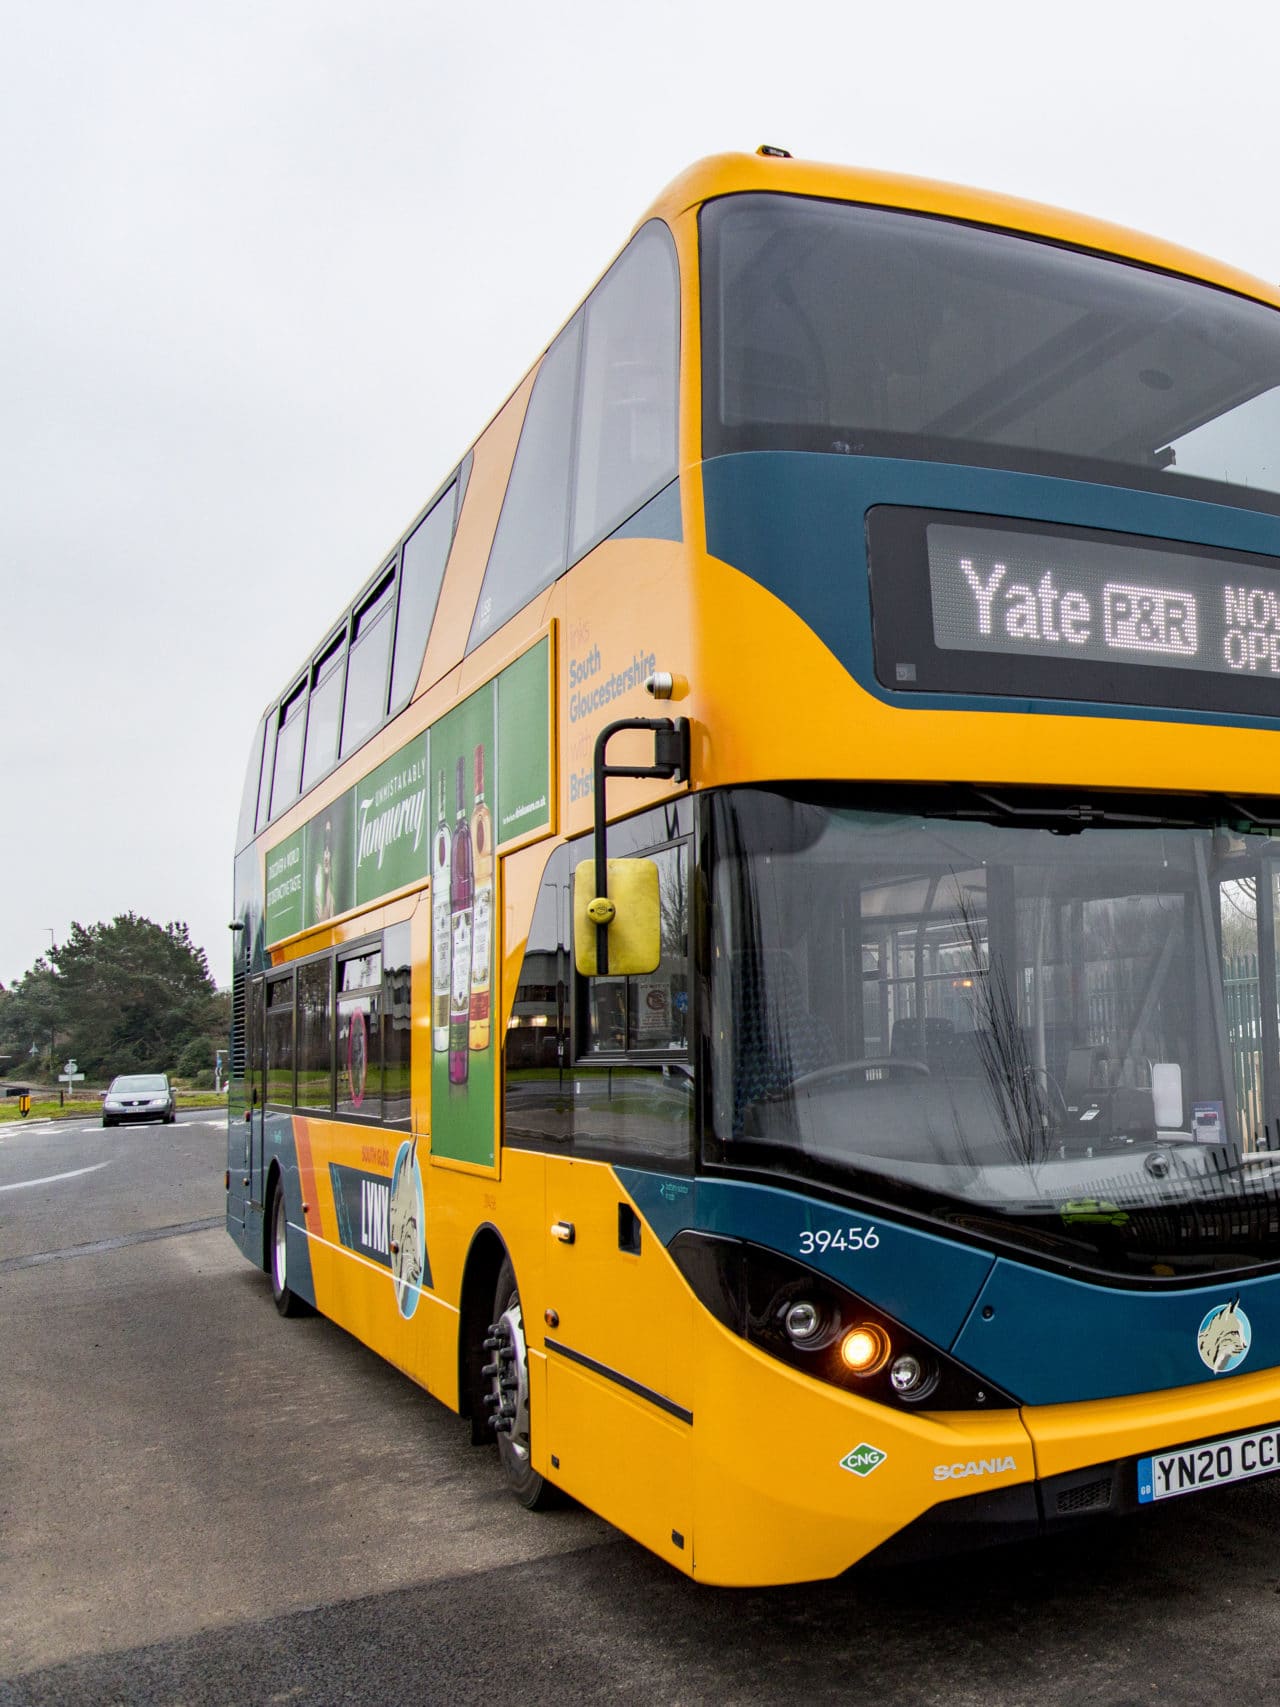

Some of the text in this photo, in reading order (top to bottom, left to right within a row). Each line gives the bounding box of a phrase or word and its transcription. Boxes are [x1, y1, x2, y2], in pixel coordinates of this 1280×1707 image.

[960, 559, 1195, 652] Yate P&R
[569, 642, 601, 689] South
[569, 649, 657, 724] Gloucestershire
[375, 757, 426, 807] UNMISTAKABLY
[357, 788, 426, 870] Tanqueray
[361, 1180, 389, 1255] LYNX
[799, 1226, 880, 1254] 39456
[847, 1452, 880, 1468] CNG
[933, 1455, 1017, 1481] SCANIA
[1158, 1446, 1233, 1492] YN20
